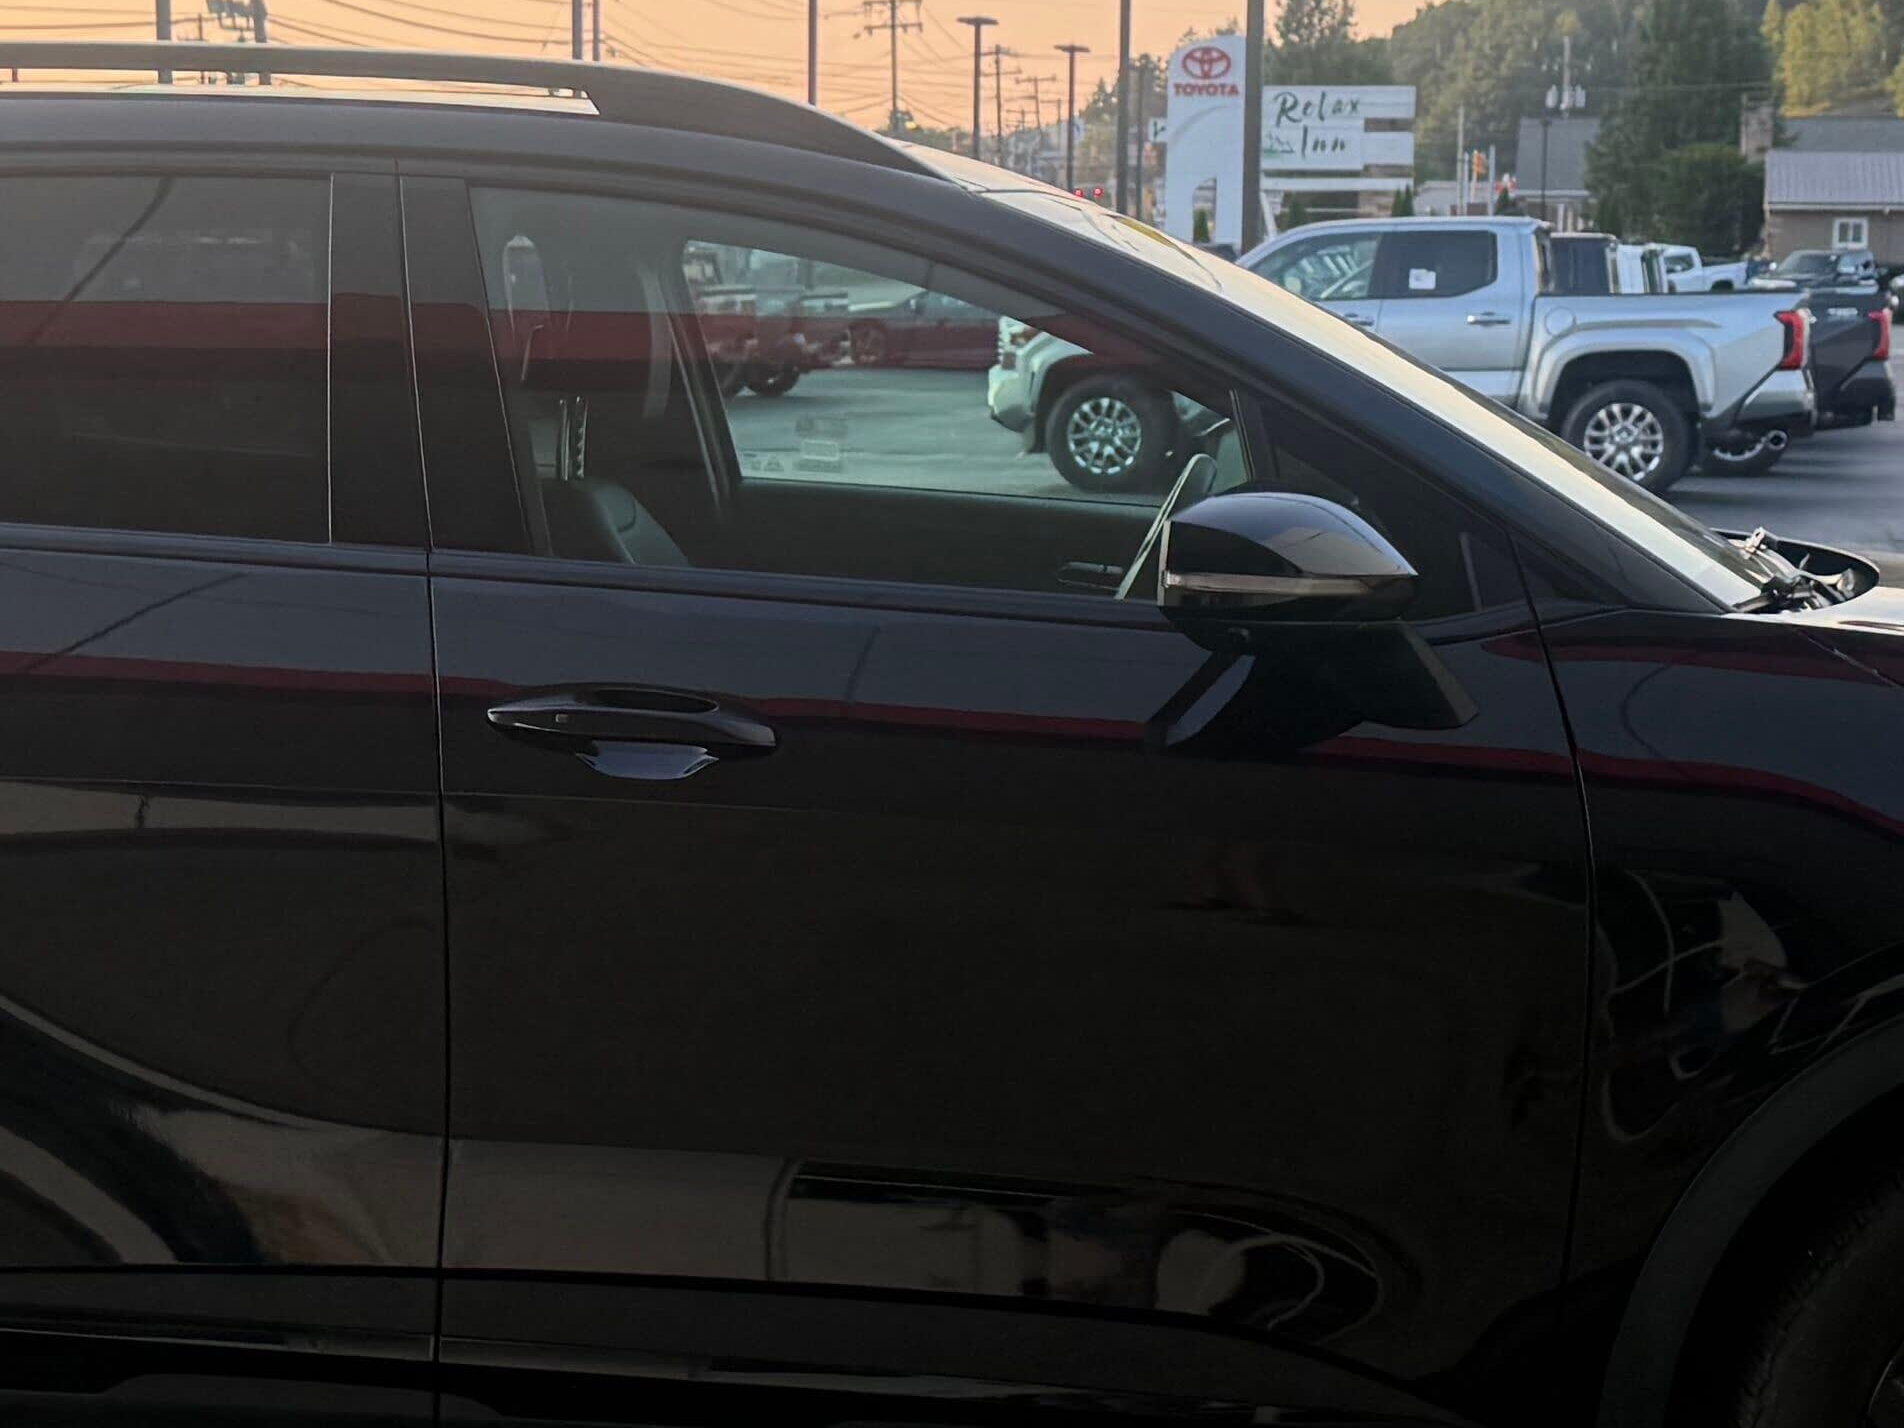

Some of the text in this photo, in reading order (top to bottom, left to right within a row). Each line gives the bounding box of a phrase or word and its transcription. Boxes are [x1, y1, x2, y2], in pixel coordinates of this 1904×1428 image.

[1173, 83, 1239, 97] TOYOTA
[1274, 90, 1362, 128] Relax
[1301, 125, 1346, 159] Inn
